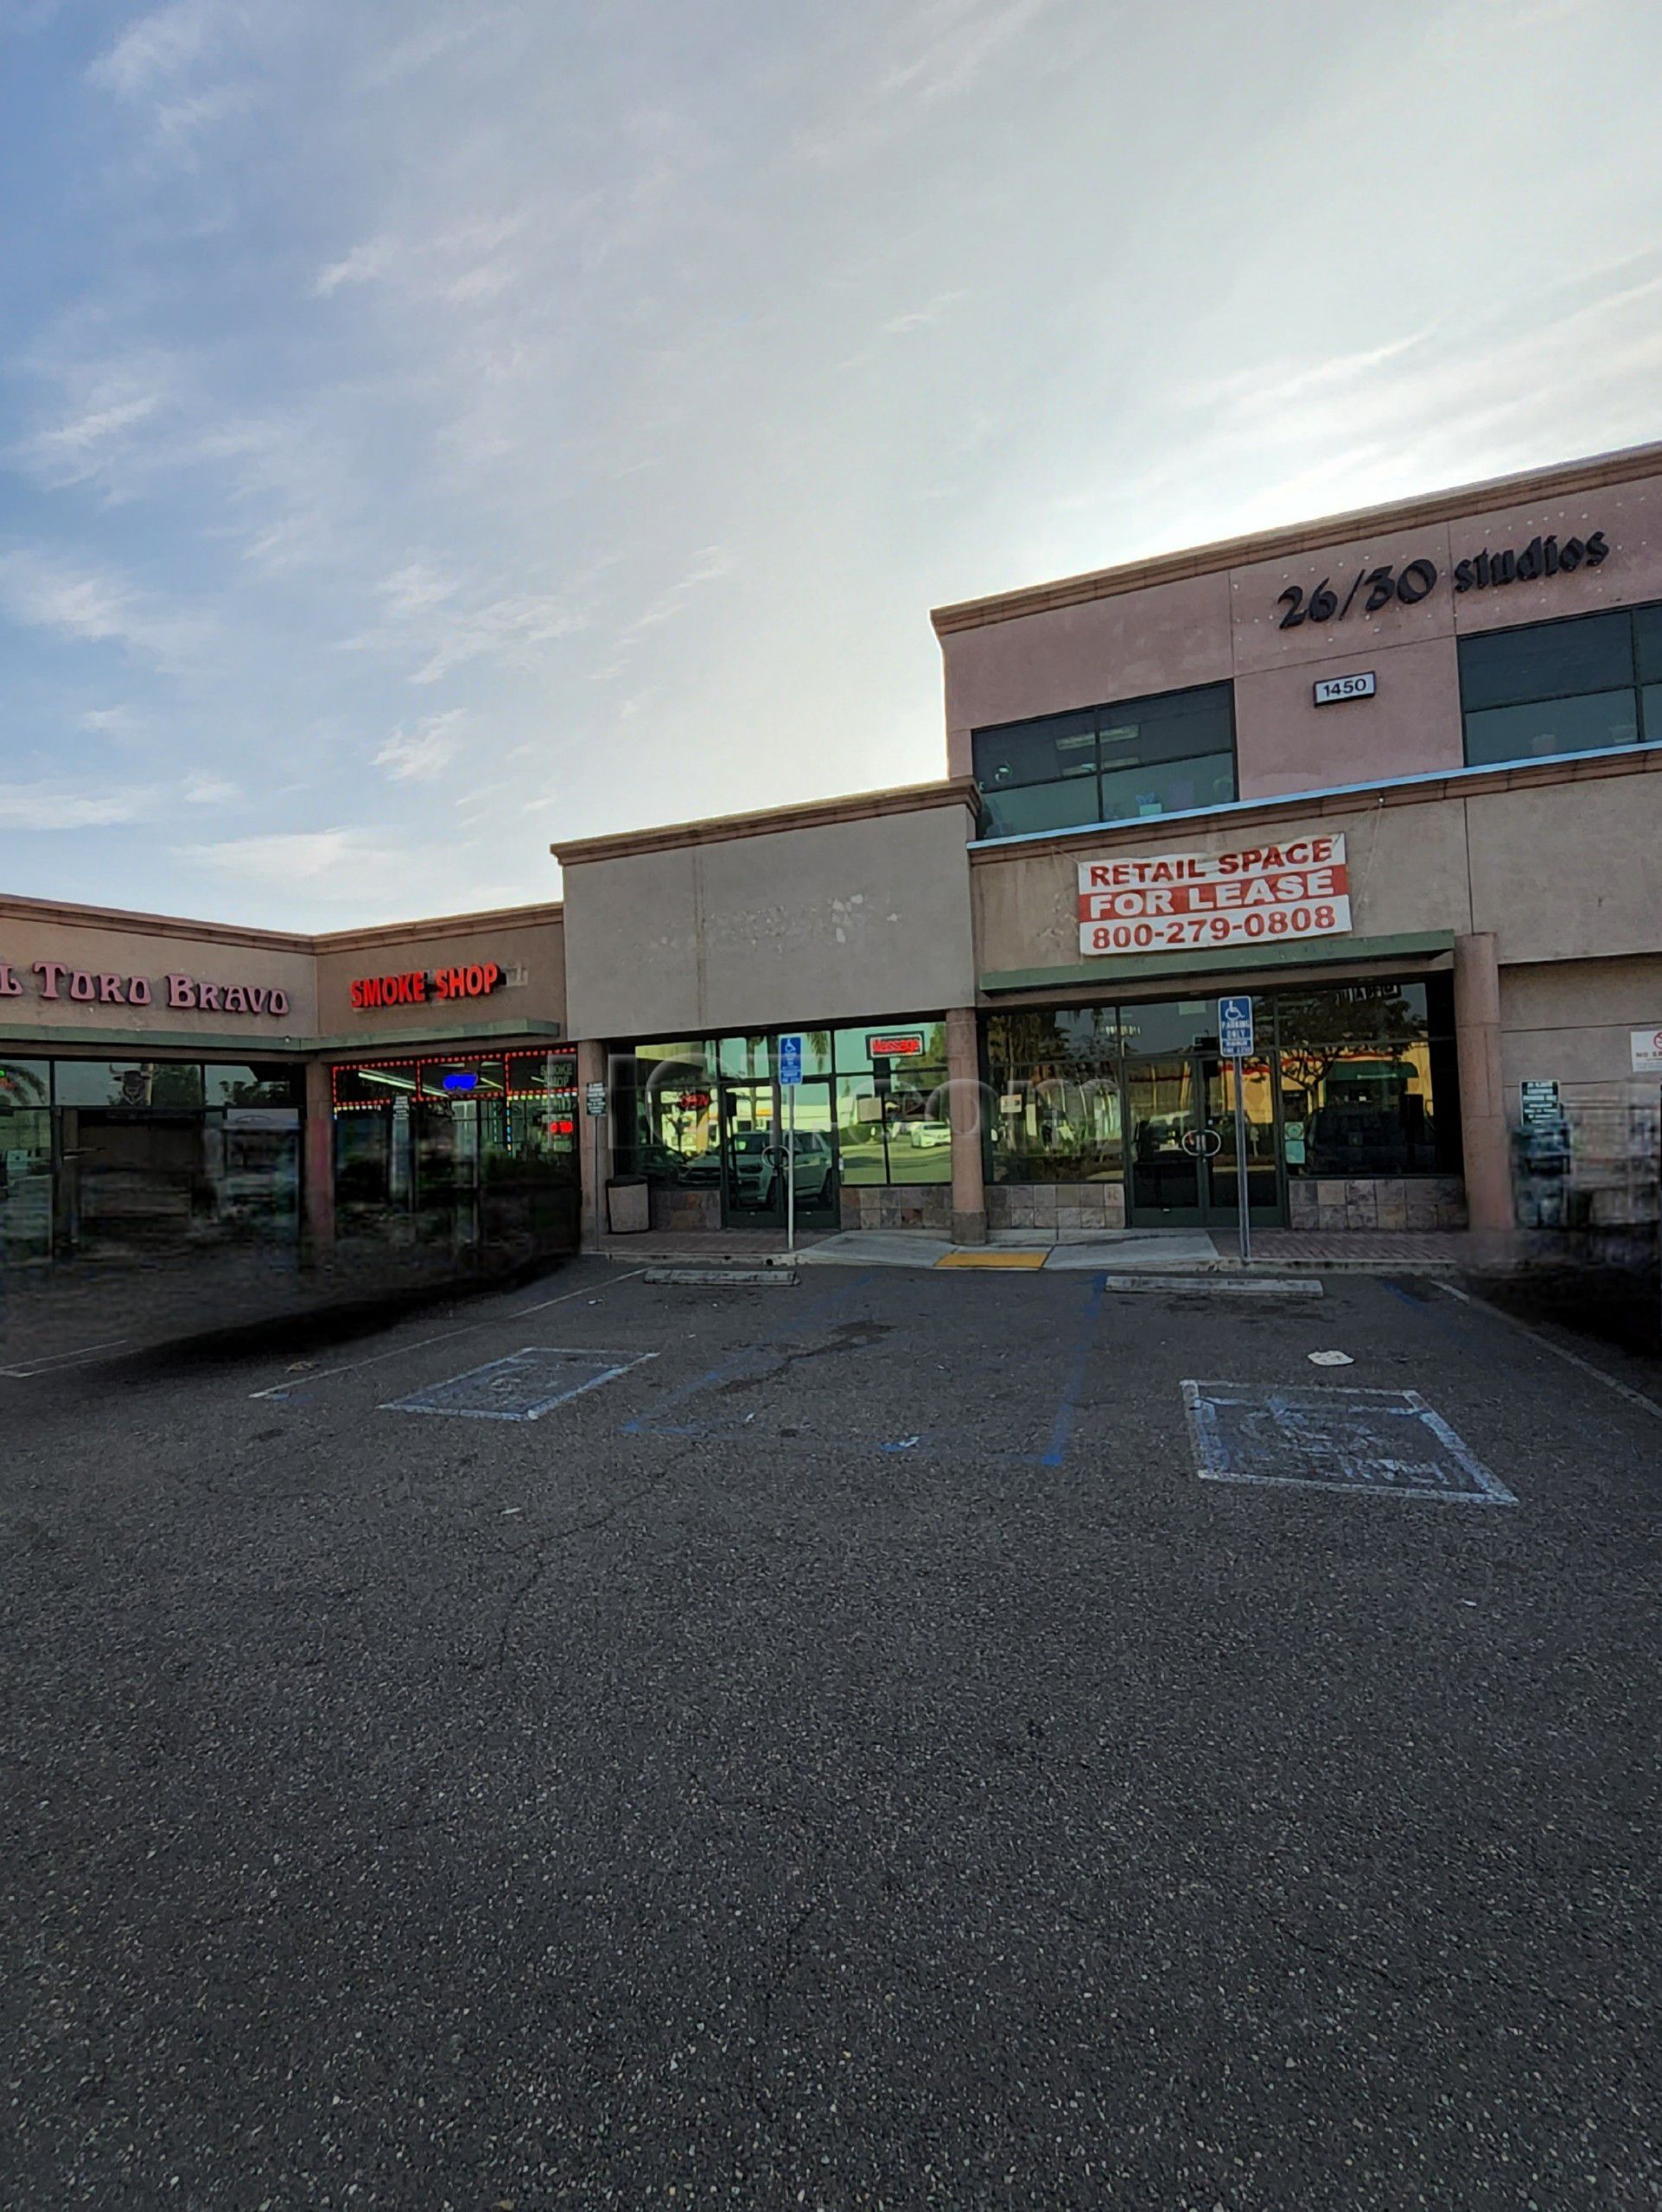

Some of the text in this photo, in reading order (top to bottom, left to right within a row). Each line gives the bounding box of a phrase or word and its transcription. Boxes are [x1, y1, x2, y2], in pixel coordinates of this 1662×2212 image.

[1277, 531, 1610, 629] 26/30 studios
[1323, 678, 1367, 697] 1450
[1090, 838, 1334, 887] RETAIL SPACE
[1089, 868, 1334, 919] FOR LEASE
[1092, 906, 1336, 950] 800-279-0808
[350, 962, 499, 1008] SMOKE SHOP
